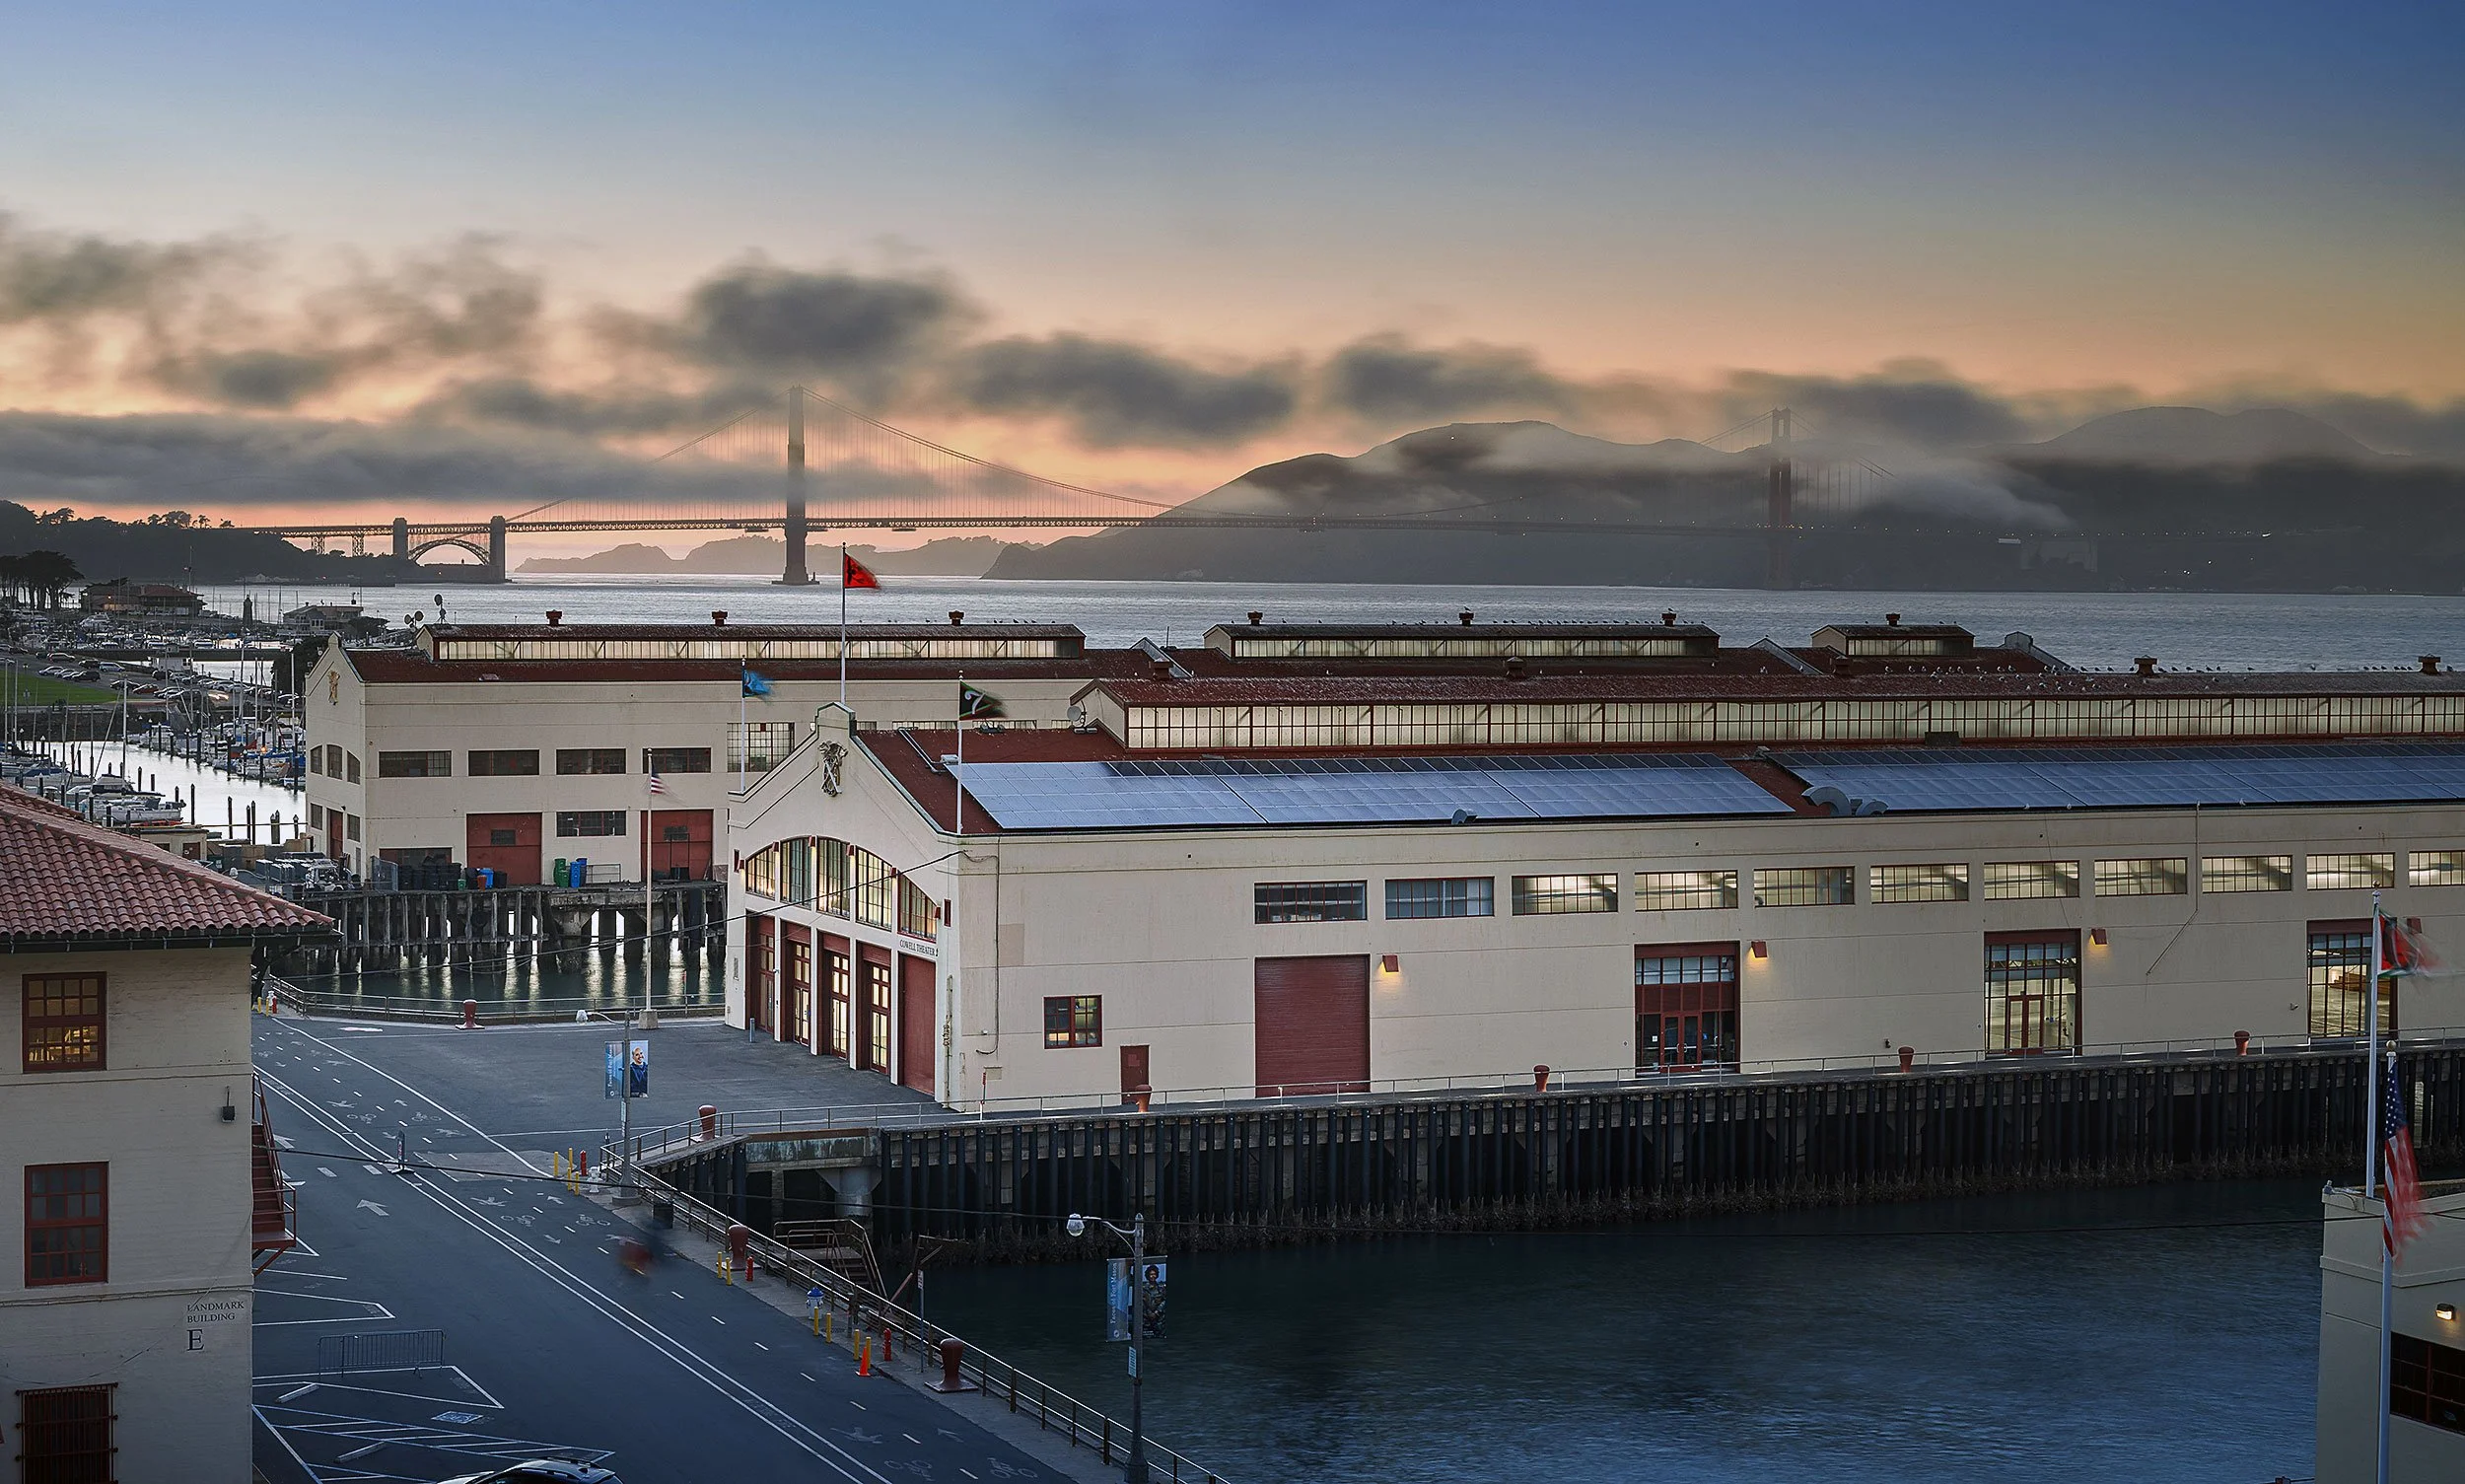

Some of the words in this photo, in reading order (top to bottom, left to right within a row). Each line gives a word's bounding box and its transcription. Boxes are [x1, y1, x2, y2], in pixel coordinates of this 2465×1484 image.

[916, 943, 935, 955] THEATER
[187, 1301, 245, 1311] LANDMARK
[187, 1312, 236, 1323] BUILDING
[186, 1328, 205, 1351] E
